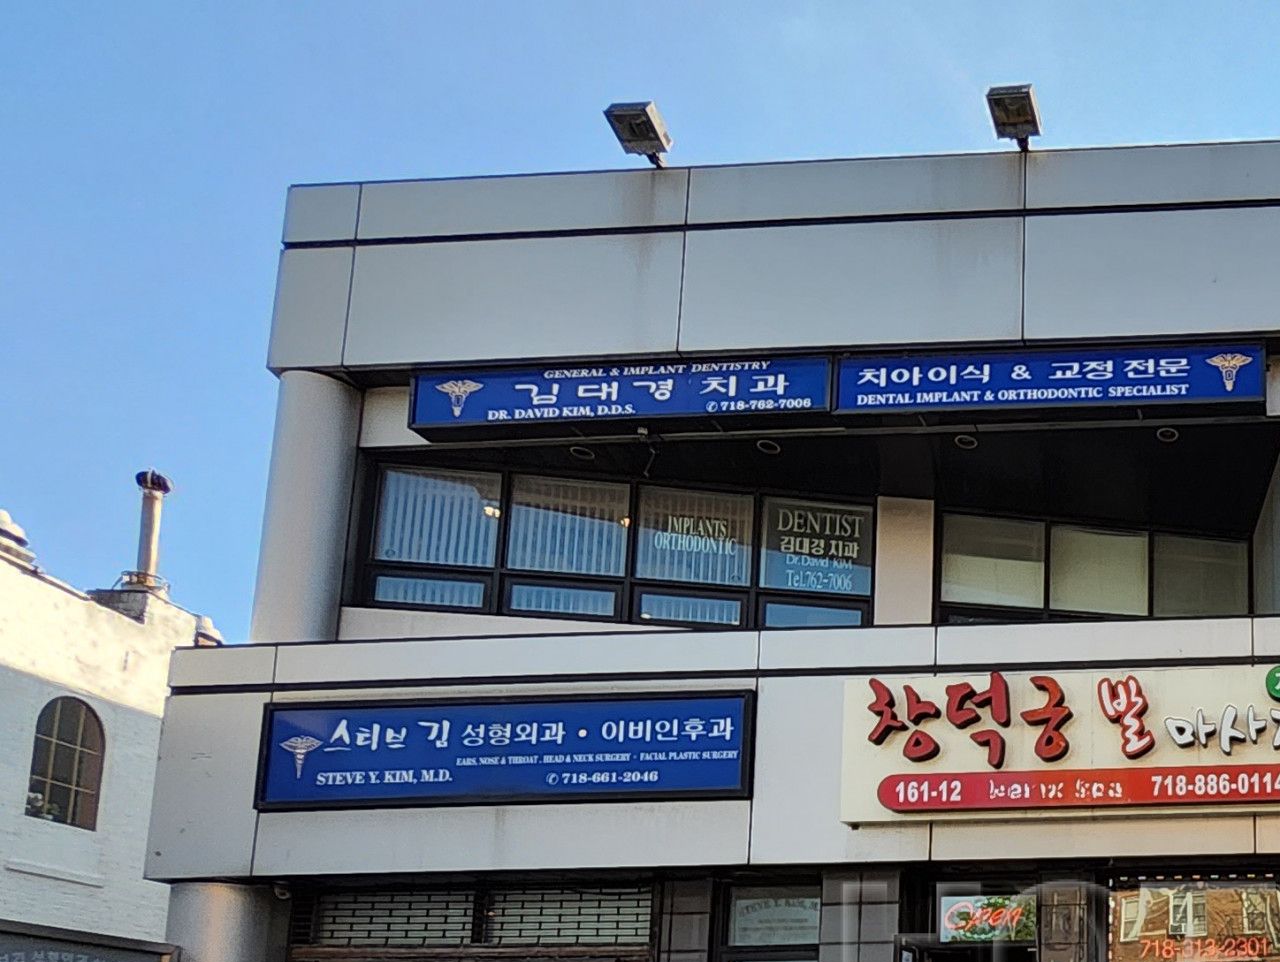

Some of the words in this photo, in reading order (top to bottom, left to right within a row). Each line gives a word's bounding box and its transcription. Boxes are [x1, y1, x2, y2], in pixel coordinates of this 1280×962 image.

[544, 368, 607, 380] GENERAL
[610, 367, 619, 377] &
[623, 364, 686, 377] IMPLANT
[691, 361, 771, 374] DENTISTRY
[1011, 363, 1033, 382] &
[1048, 361, 1114, 382] 교정
[1123, 358, 1191, 380] 전문
[720, 398, 812, 411] 718-762-7006
[857, 393, 915, 406] DENTAL
[916, 390, 981, 405] IMPLANT
[983, 389, 995, 402] &
[998, 386, 1103, 401] ORTHODONTIC
[1108, 383, 1189, 398] SPECIALIST
[487, 410, 511, 421] DR.
[514, 407, 560, 420] DAVID
[562, 405, 595, 420] KIM,
[597, 403, 636, 417] D.D.S.
[668, 515, 728, 538] IMPLANTS
[777, 509, 864, 538] DENTIST
[654, 531, 738, 556] ORTHODONTIC
[867, 671, 1074, 769] 창덕궁
[1098, 674, 1155, 760] 발
[323, 719, 408, 752] 스티브
[417, 720, 449, 748] 김
[460, 721, 566, 747] 성형외과
[601, 717, 734, 744] 이비인후과
[572, 753, 594, 763] NECK
[595, 752, 631, 762] SURGERY
[639, 751, 667, 761] FACIAL
[668, 751, 700, 760] PLASTIC
[701, 750, 739, 760] SURGERY
[316, 771, 366, 786] STEVE
[369, 771, 381, 785] Y.
[383, 770, 418, 785] KIM,
[420, 768, 453, 783] M.D.
[562, 770, 658, 784] 718-661-2046
[895, 779, 962, 803] 161-12
